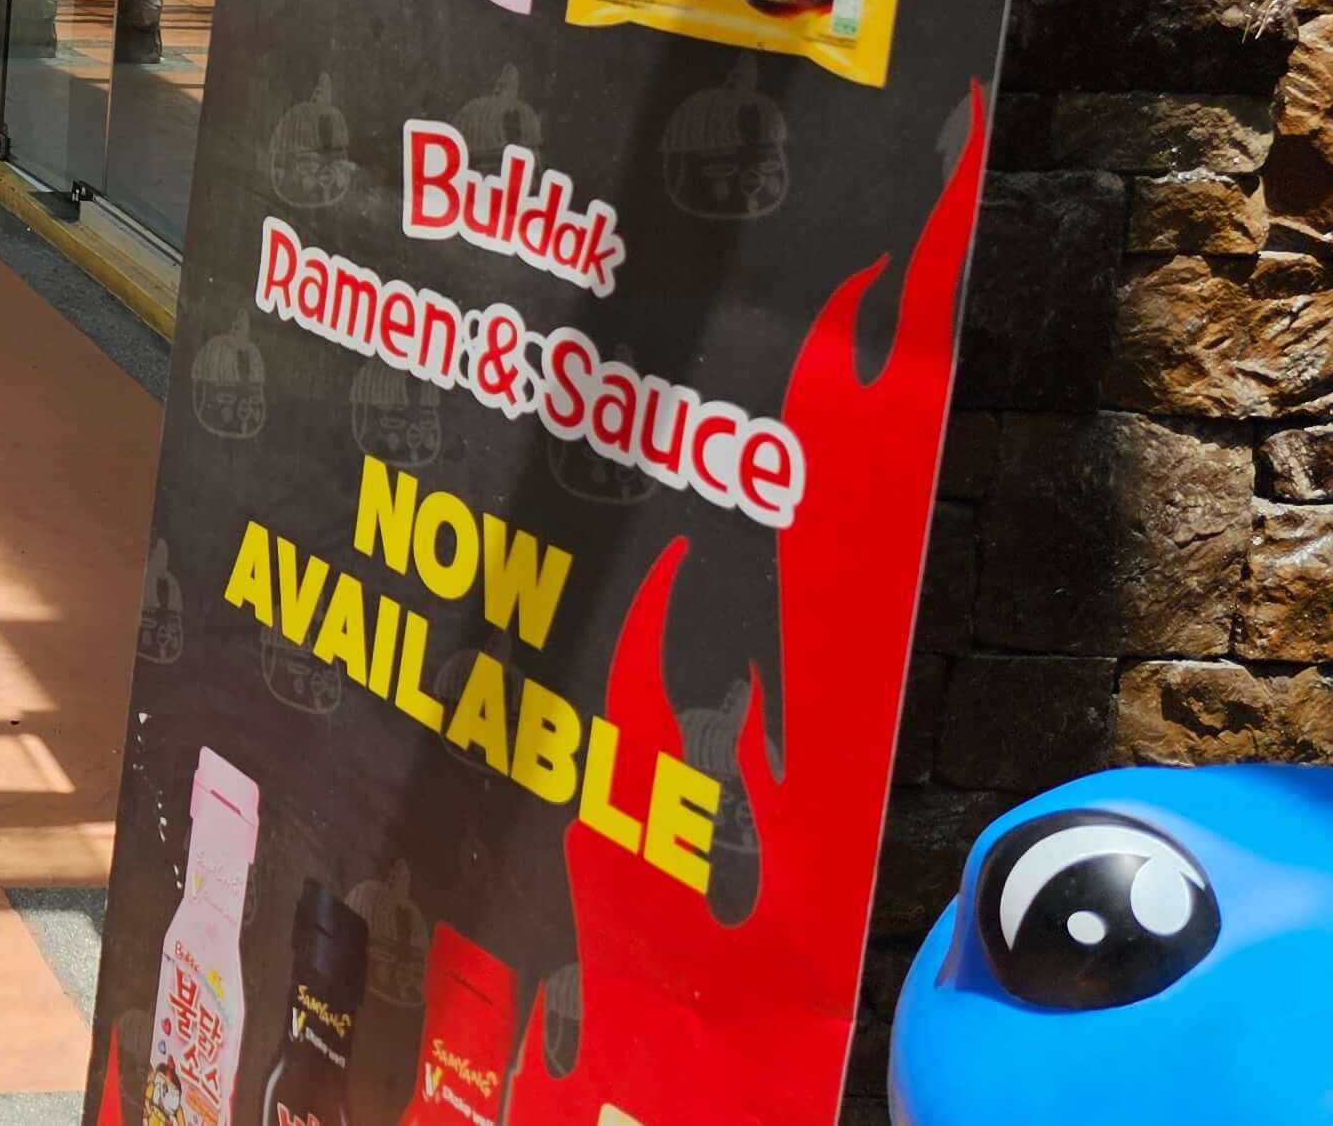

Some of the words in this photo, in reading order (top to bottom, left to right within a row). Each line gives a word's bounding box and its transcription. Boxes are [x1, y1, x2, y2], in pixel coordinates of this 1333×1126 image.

[406, 124, 623, 292] Buldak
[260, 222, 461, 382] Ramen
[473, 310, 522, 412] &
[540, 332, 799, 521] Sauce
[353, 455, 572, 649] NOW
[224, 521, 721, 896] AVAILABLE
